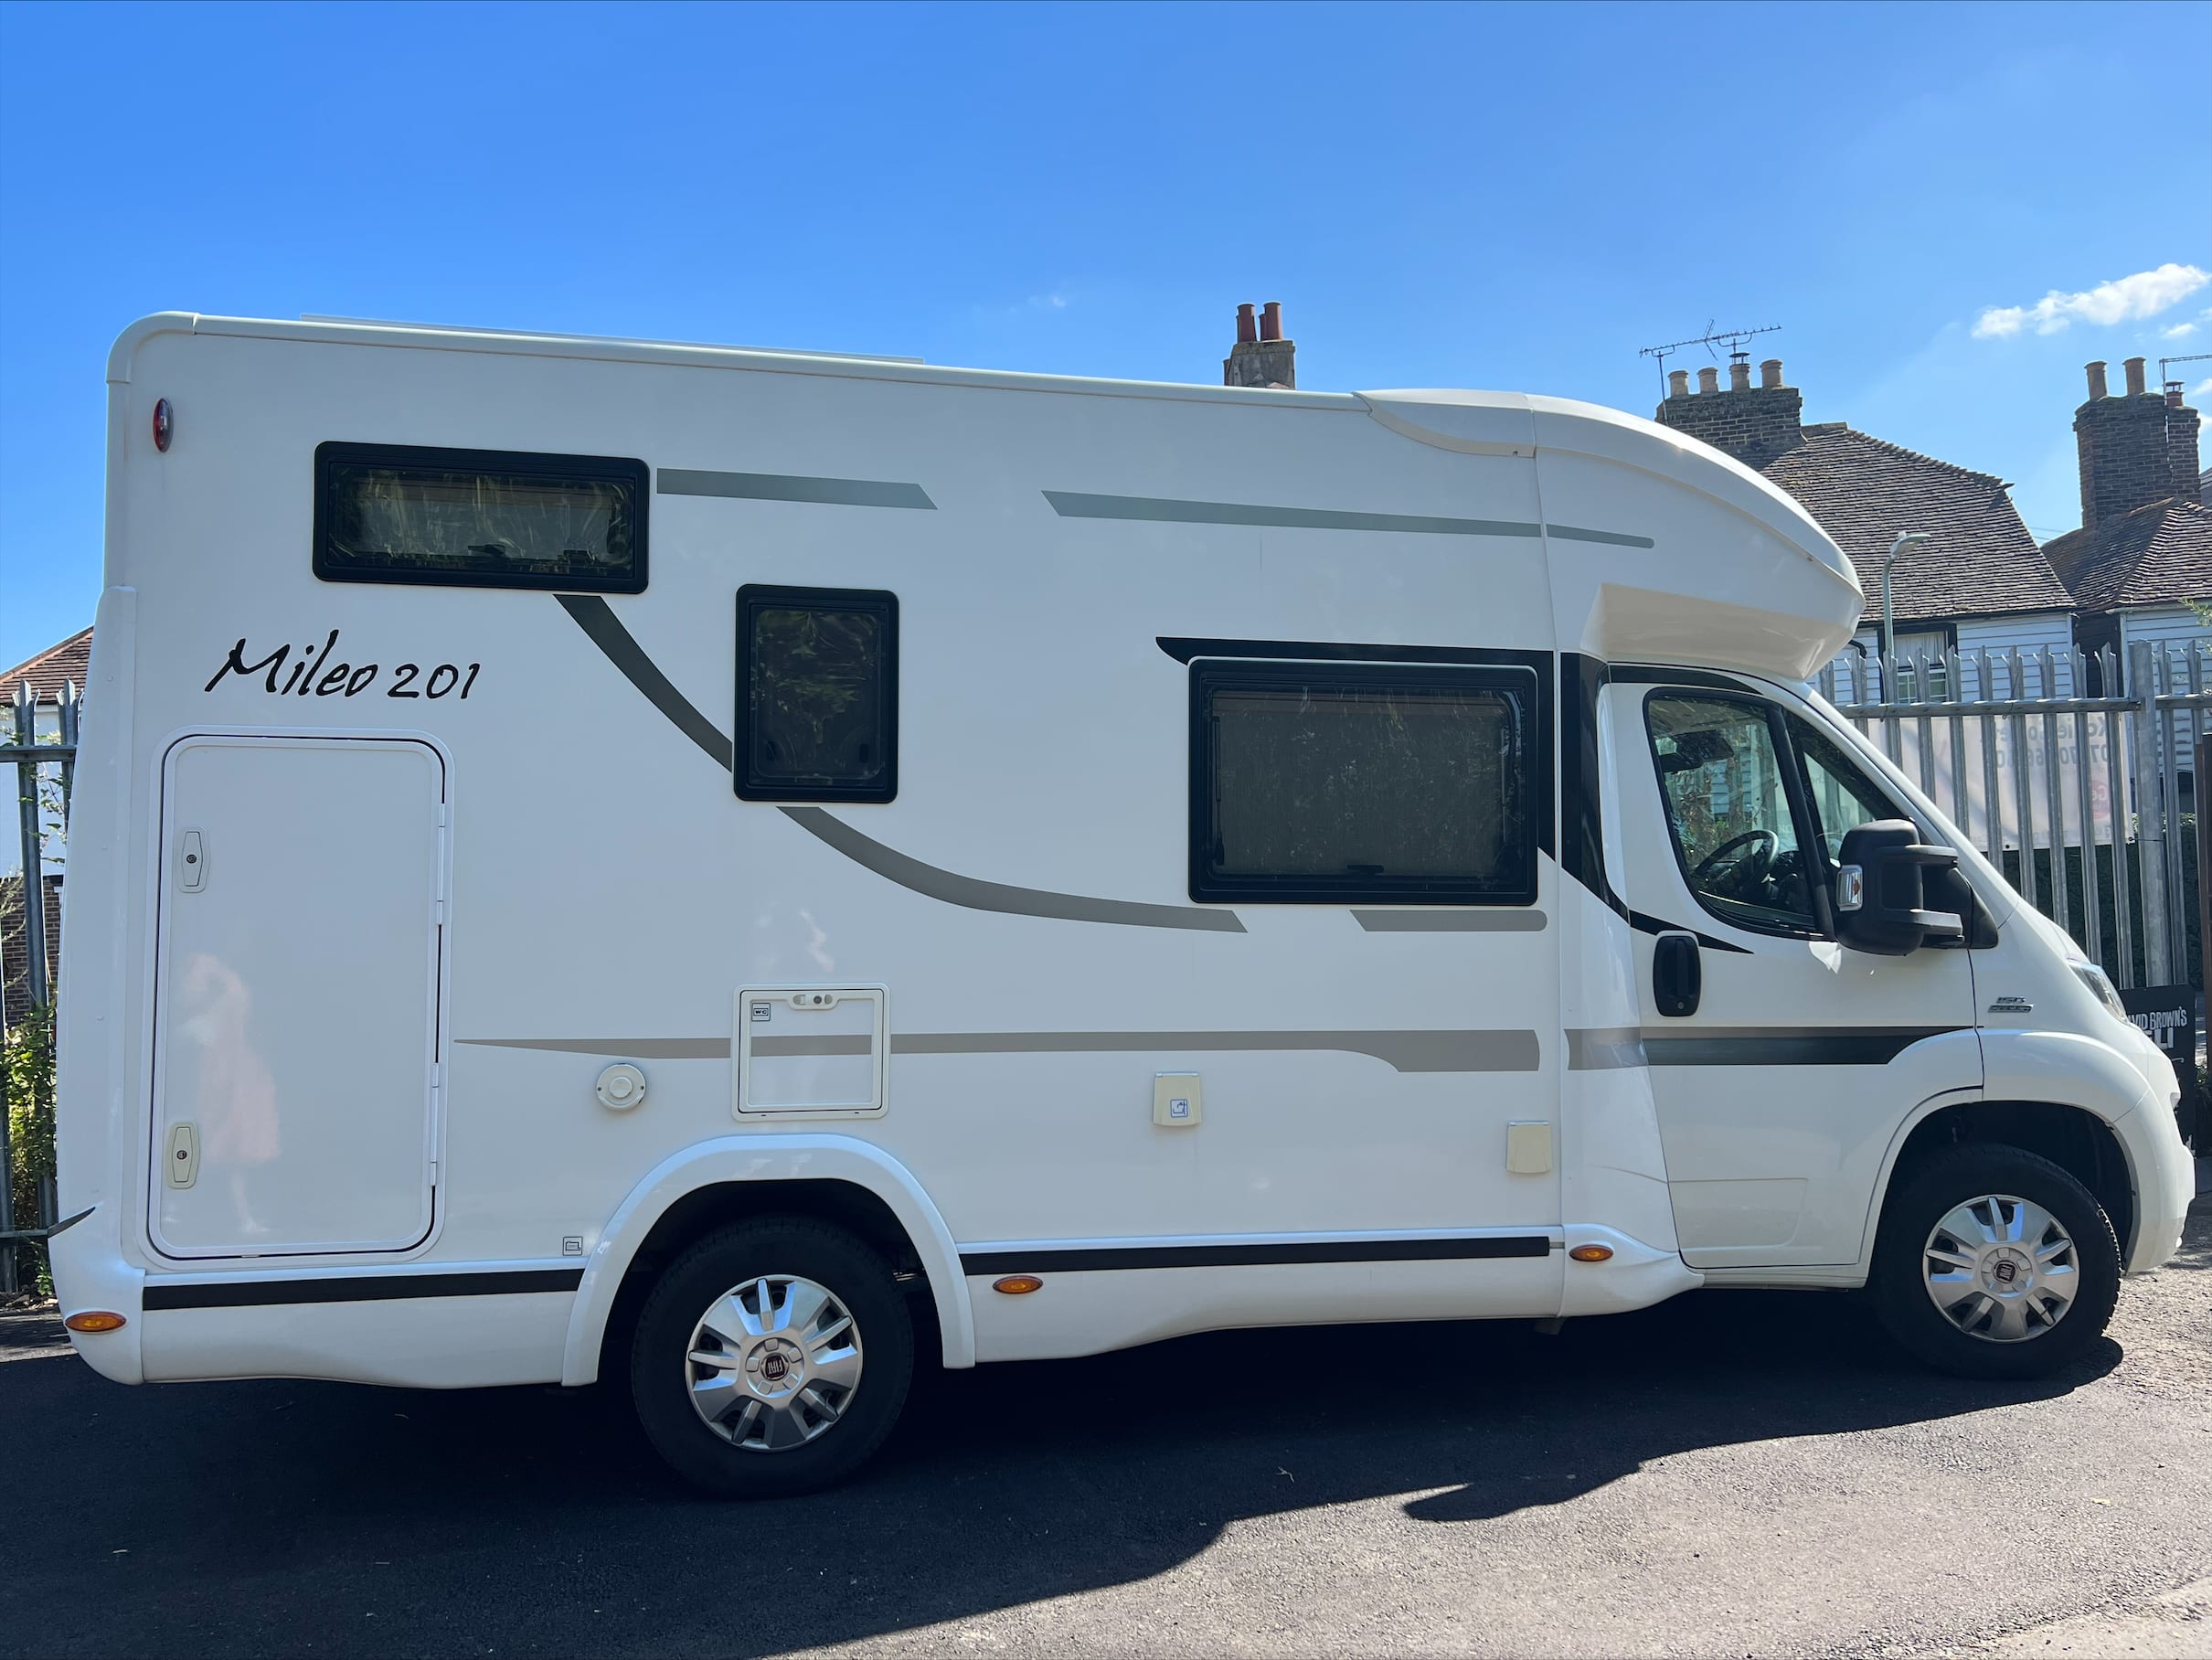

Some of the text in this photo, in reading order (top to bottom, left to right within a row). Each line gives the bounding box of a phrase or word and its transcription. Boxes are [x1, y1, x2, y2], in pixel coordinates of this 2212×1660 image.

[204, 628, 481, 700] Mileo 201
[2127, 1006, 2188, 1030] VID BROWN'S
[2142, 1027, 2175, 1049] LI
[767, 1359, 783, 1376] FIAT
